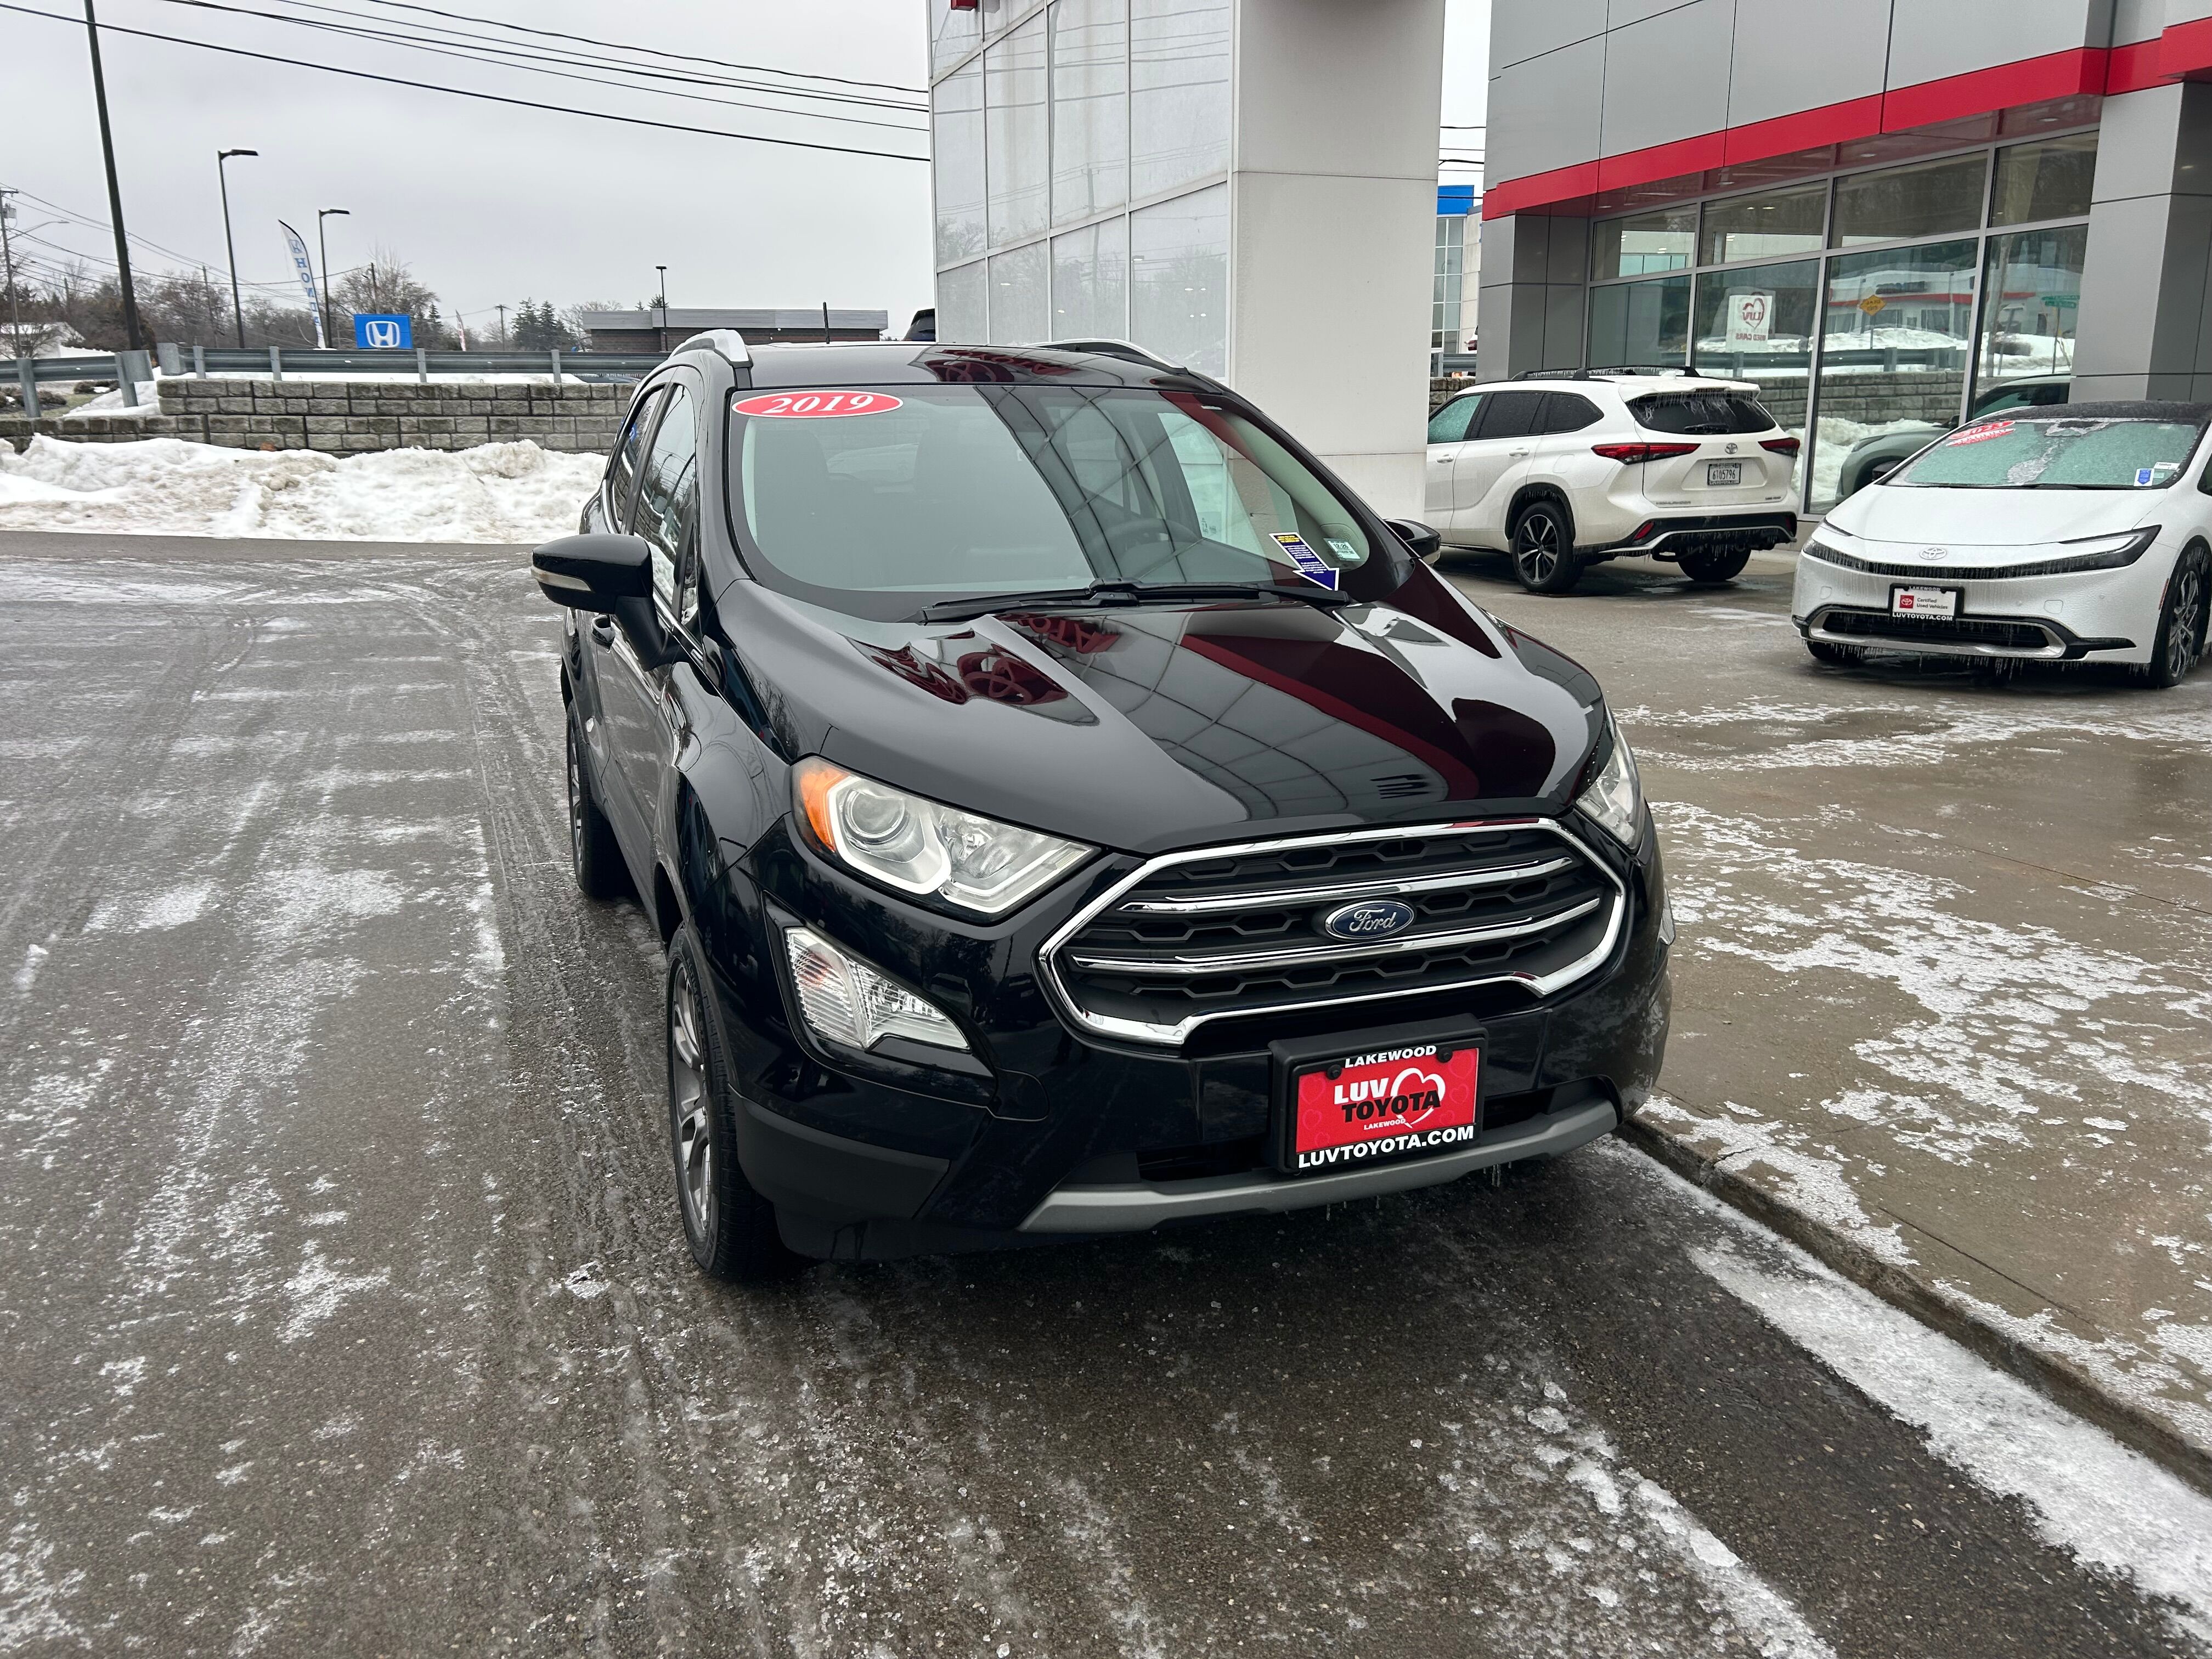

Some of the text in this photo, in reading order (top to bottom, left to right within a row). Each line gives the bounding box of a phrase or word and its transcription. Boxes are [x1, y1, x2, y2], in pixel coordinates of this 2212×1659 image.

[761, 394, 874, 414] 2019
[1892, 612, 1953, 622] LUVTOYOTA.COM
[1349, 908, 1397, 932] Ford
[1345, 1045, 1437, 1069] LAKEWOOD
[1334, 1077, 1390, 1105] LUV
[1342, 1090, 1441, 1123] TOYOTA
[1363, 1118, 1406, 1131] LAKEWOOD
[1298, 1125, 1474, 1169] LUVTOYOTA.COM
